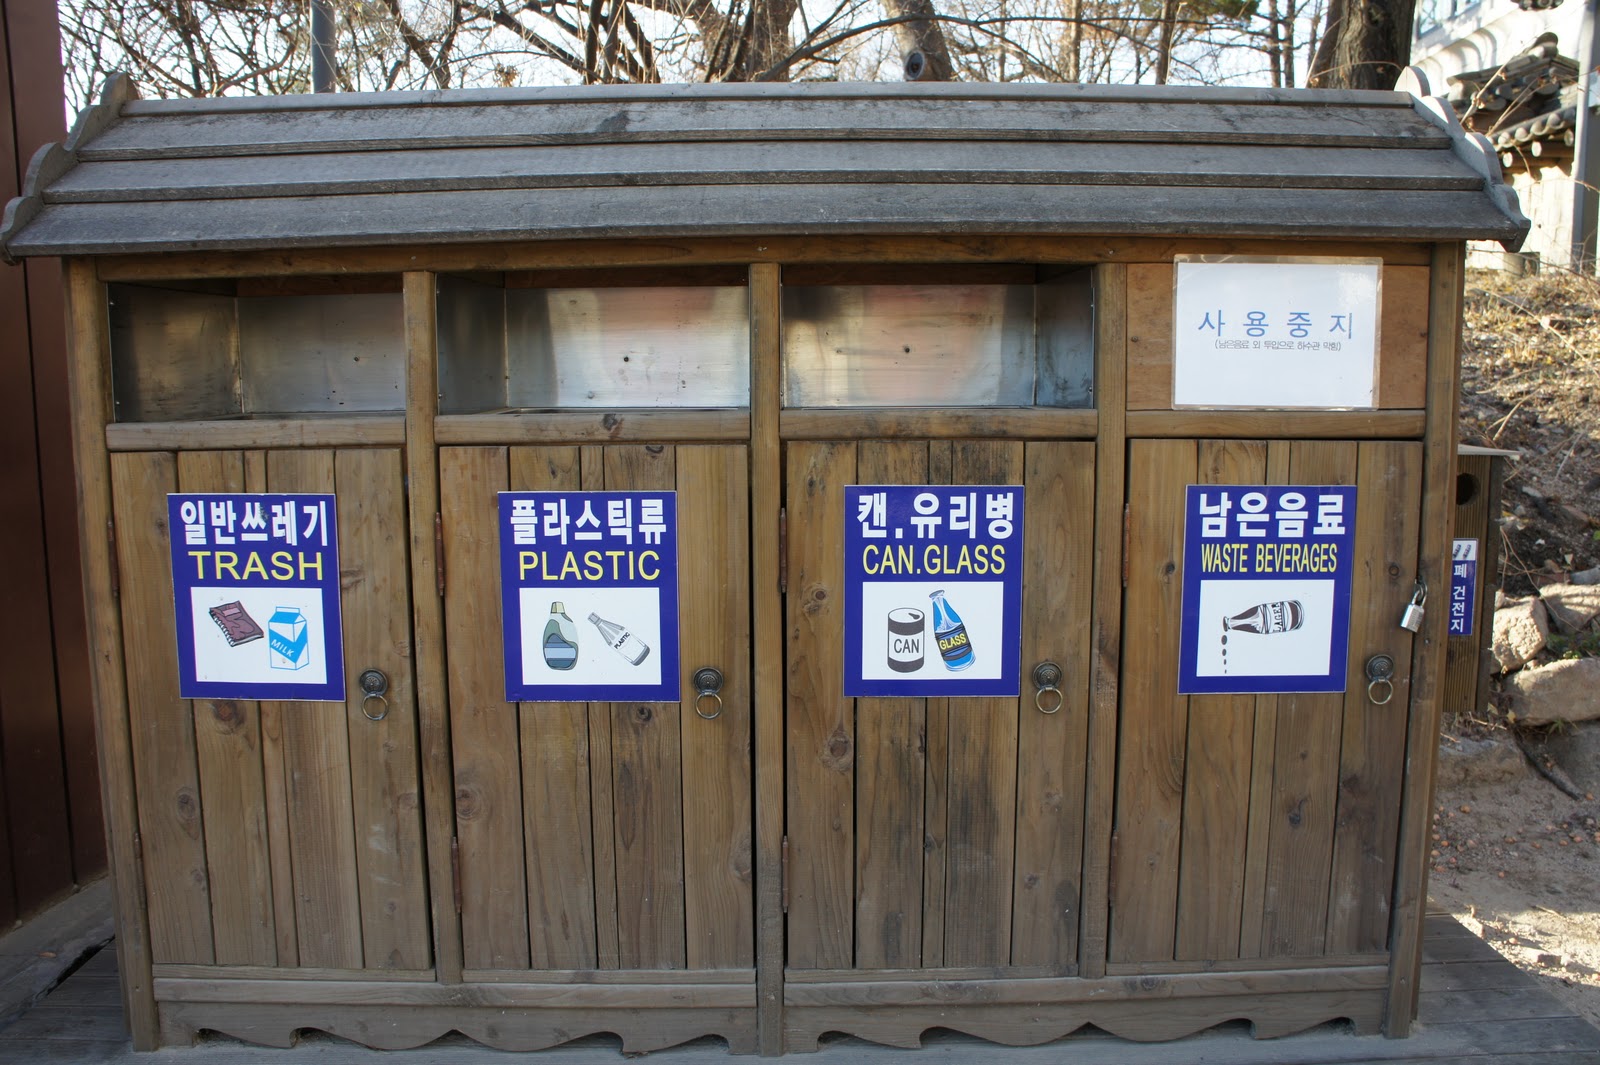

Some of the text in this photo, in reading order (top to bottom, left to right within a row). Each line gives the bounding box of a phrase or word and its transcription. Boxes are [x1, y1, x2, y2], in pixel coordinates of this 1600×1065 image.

[180, 500, 328, 546] 일반쓰레기
[510, 498, 667, 545] 플라스틱류
[1199, 492, 1346, 538] 남은음료
[188, 551, 323, 581] TRASH
[518, 550, 661, 581] PLASTIC
[1201, 543, 1338, 573] WASTE BEVERAGES
[271, 638, 295, 657] MILK
[614, 631, 631, 650] PLASTIC
[893, 638, 920, 654] CAN
[939, 633, 967, 650] GLASS
